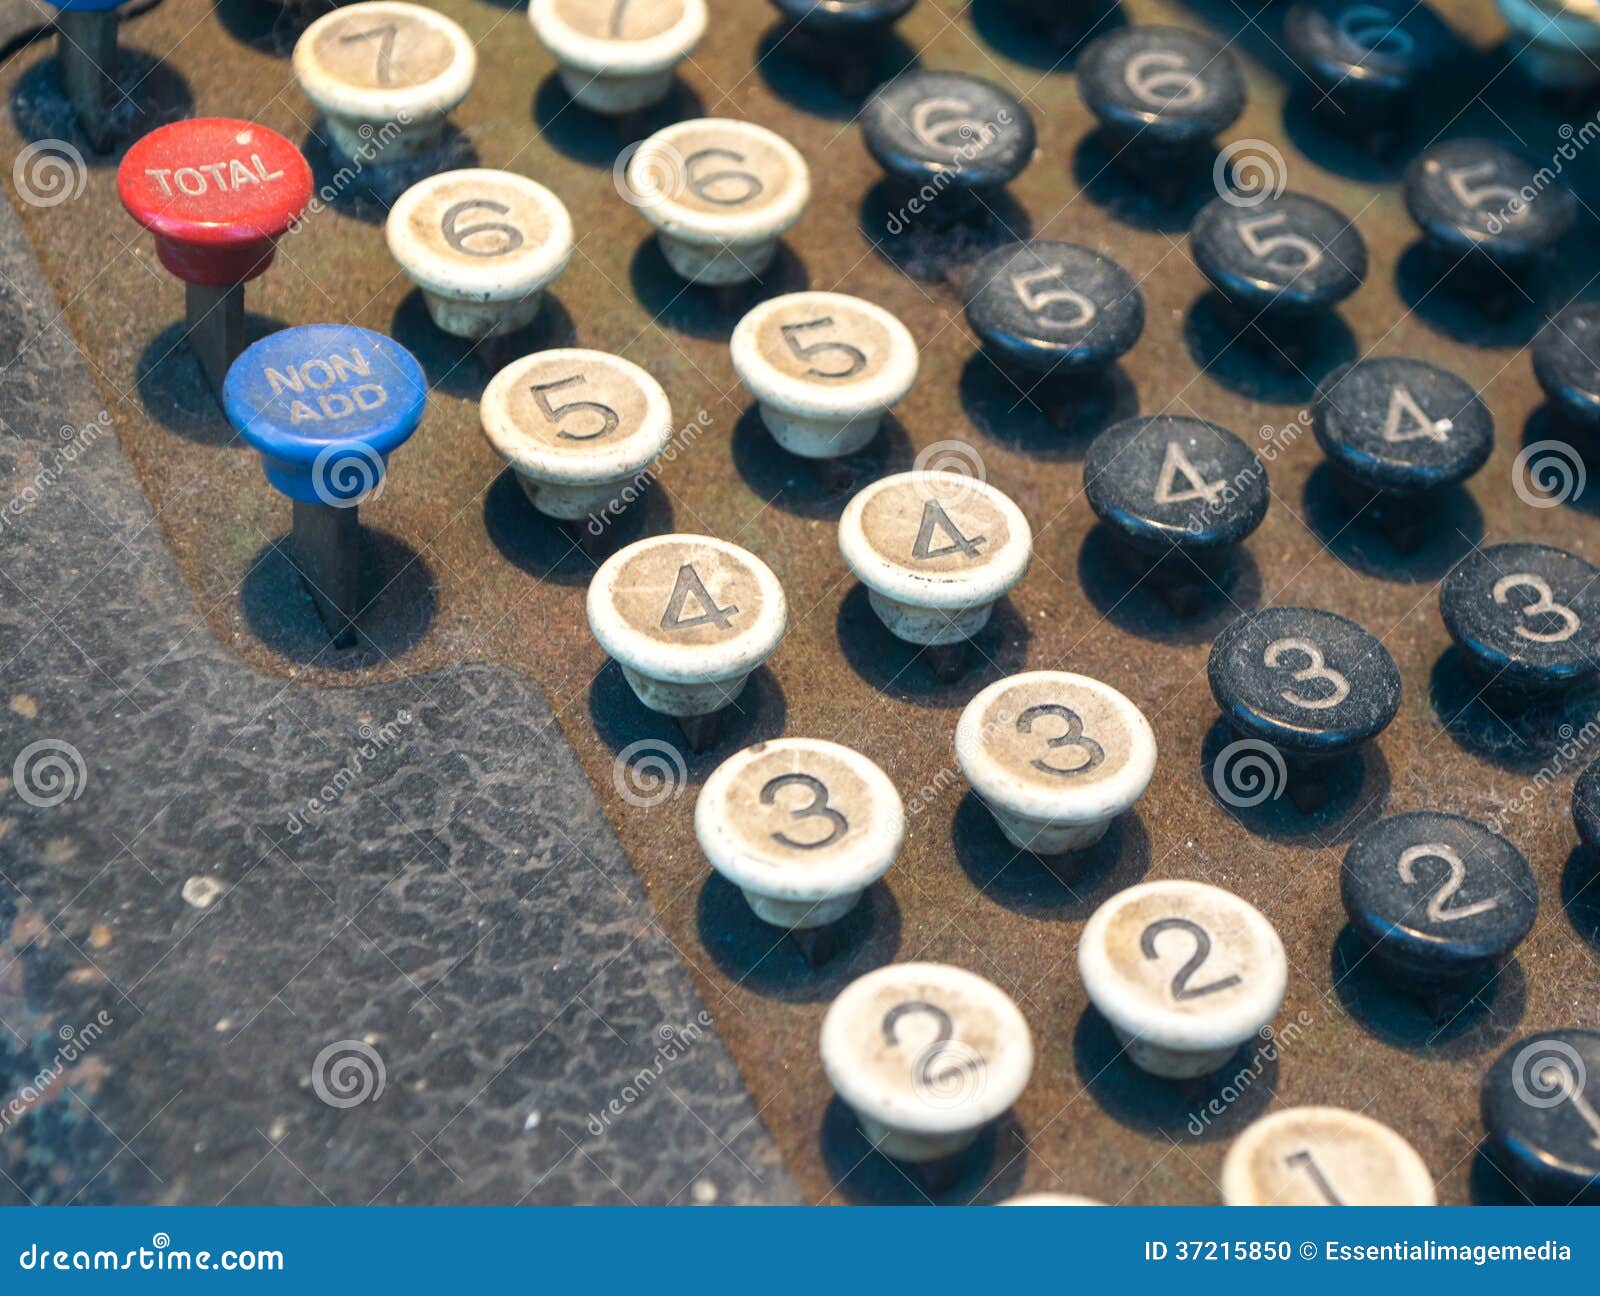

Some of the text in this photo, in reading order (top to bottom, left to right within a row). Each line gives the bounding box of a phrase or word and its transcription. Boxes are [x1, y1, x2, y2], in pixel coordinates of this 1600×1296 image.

[338, 24, 400, 84] 7
[1336, 3, 1416, 61] 6
[1124, 51, 1207, 107] 6
[913, 98, 991, 153] 6
[145, 153, 284, 198] TOTAL
[686, 147, 763, 205] 6
[1447, 162, 1532, 224] 5
[440, 199, 524, 258] 6
[1237, 211, 1322, 273] 5
[1009, 263, 1096, 330] 5
[264, 347, 371, 395] NON
[780, 315, 867, 378] 5
[288, 383, 388, 426] ADD
[530, 374, 619, 441] 5
[1383, 384, 1454, 442] 4
[1154, 441, 1228, 505] 4
[911, 499, 987, 560] 4
[660, 563, 740, 632] 4
[1493, 573, 1581, 643] 3
[1263, 637, 1350, 709] 3
[1016, 703, 1106, 777] 3
[759, 772, 849, 850] 3
[1398, 843, 1502, 923] 2
[1140, 917, 1242, 1001] 2
[882, 1001, 987, 1088] 2
